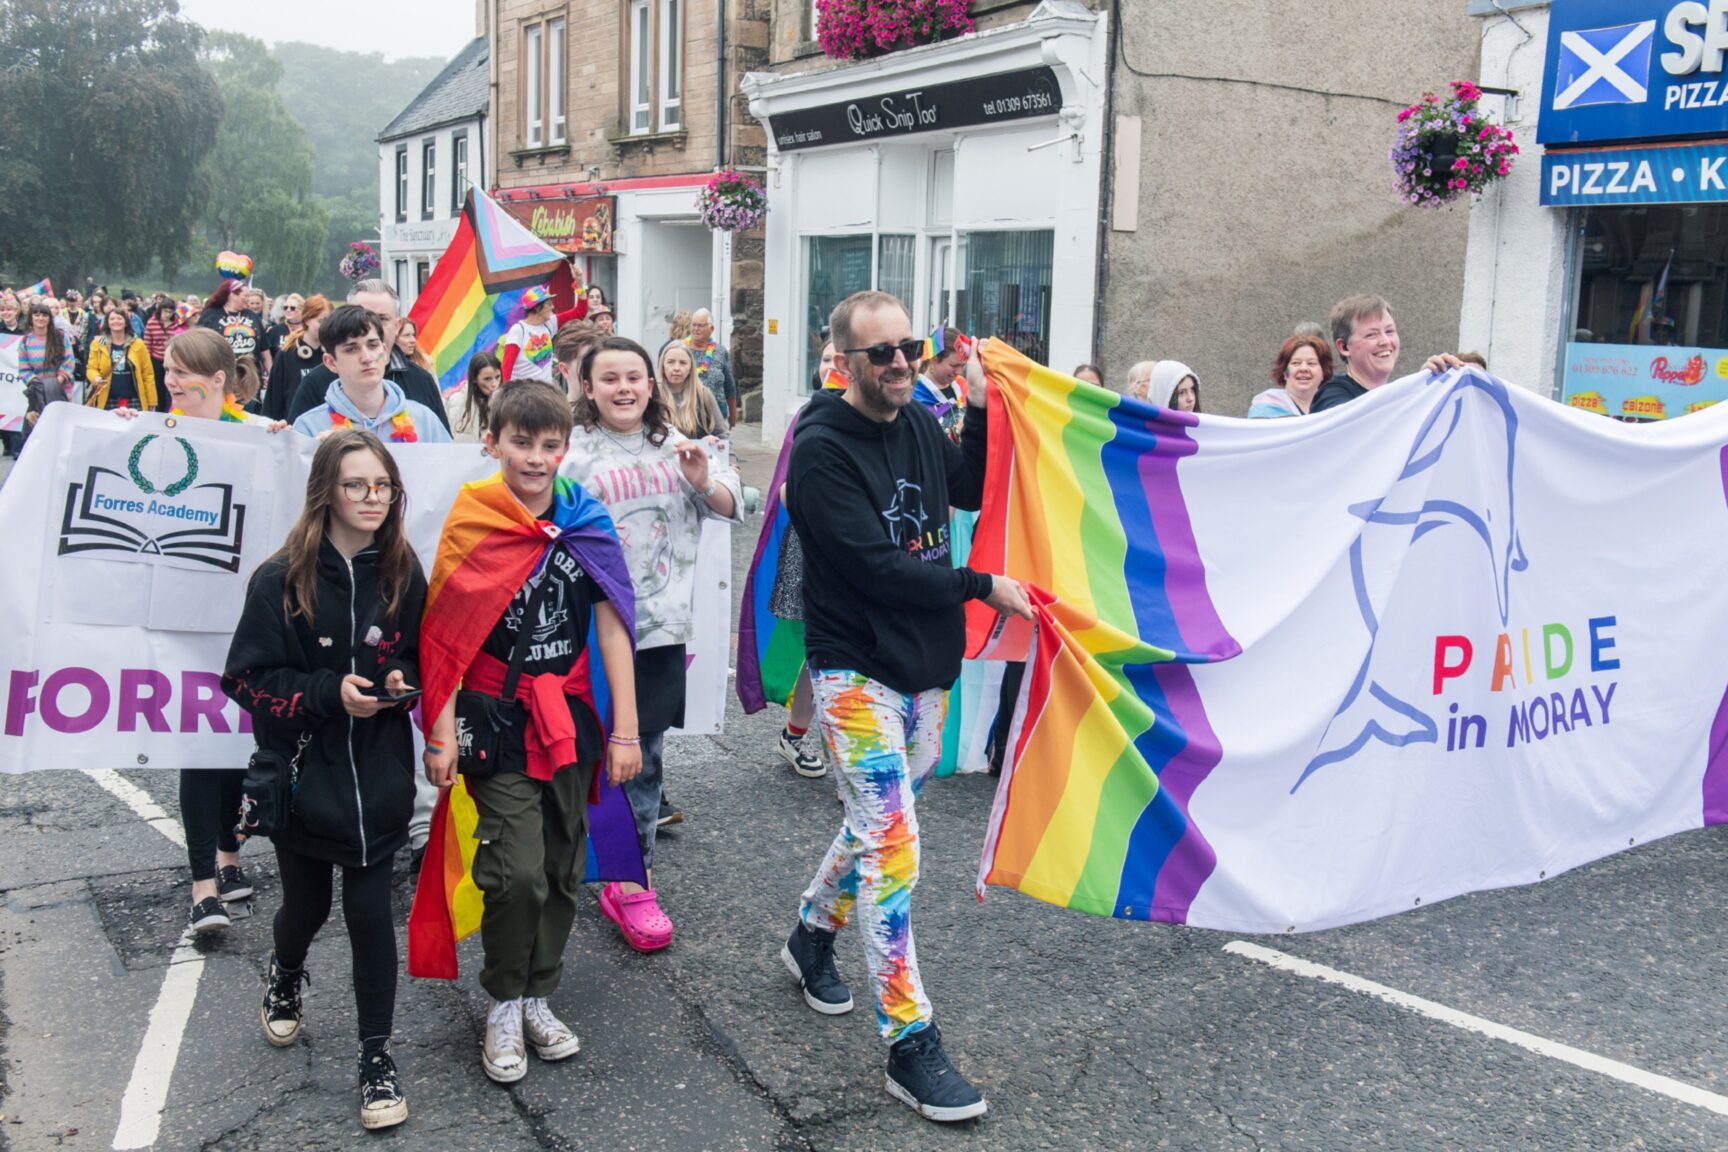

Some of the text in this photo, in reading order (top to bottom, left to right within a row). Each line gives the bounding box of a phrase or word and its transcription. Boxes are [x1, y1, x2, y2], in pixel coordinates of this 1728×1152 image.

[847, 104, 884, 135] Quick
[881, 97, 915, 131] Snip
[983, 92, 1052, 115] tel 01309 673561
[1551, 160, 1657, 197] PIZZA
[1623, 400, 1663, 413] calzone
[94, 494, 218, 526] Forres Academy
[1433, 615, 1621, 696] PRIDE
[1447, 682, 1618, 752] in MORAY
